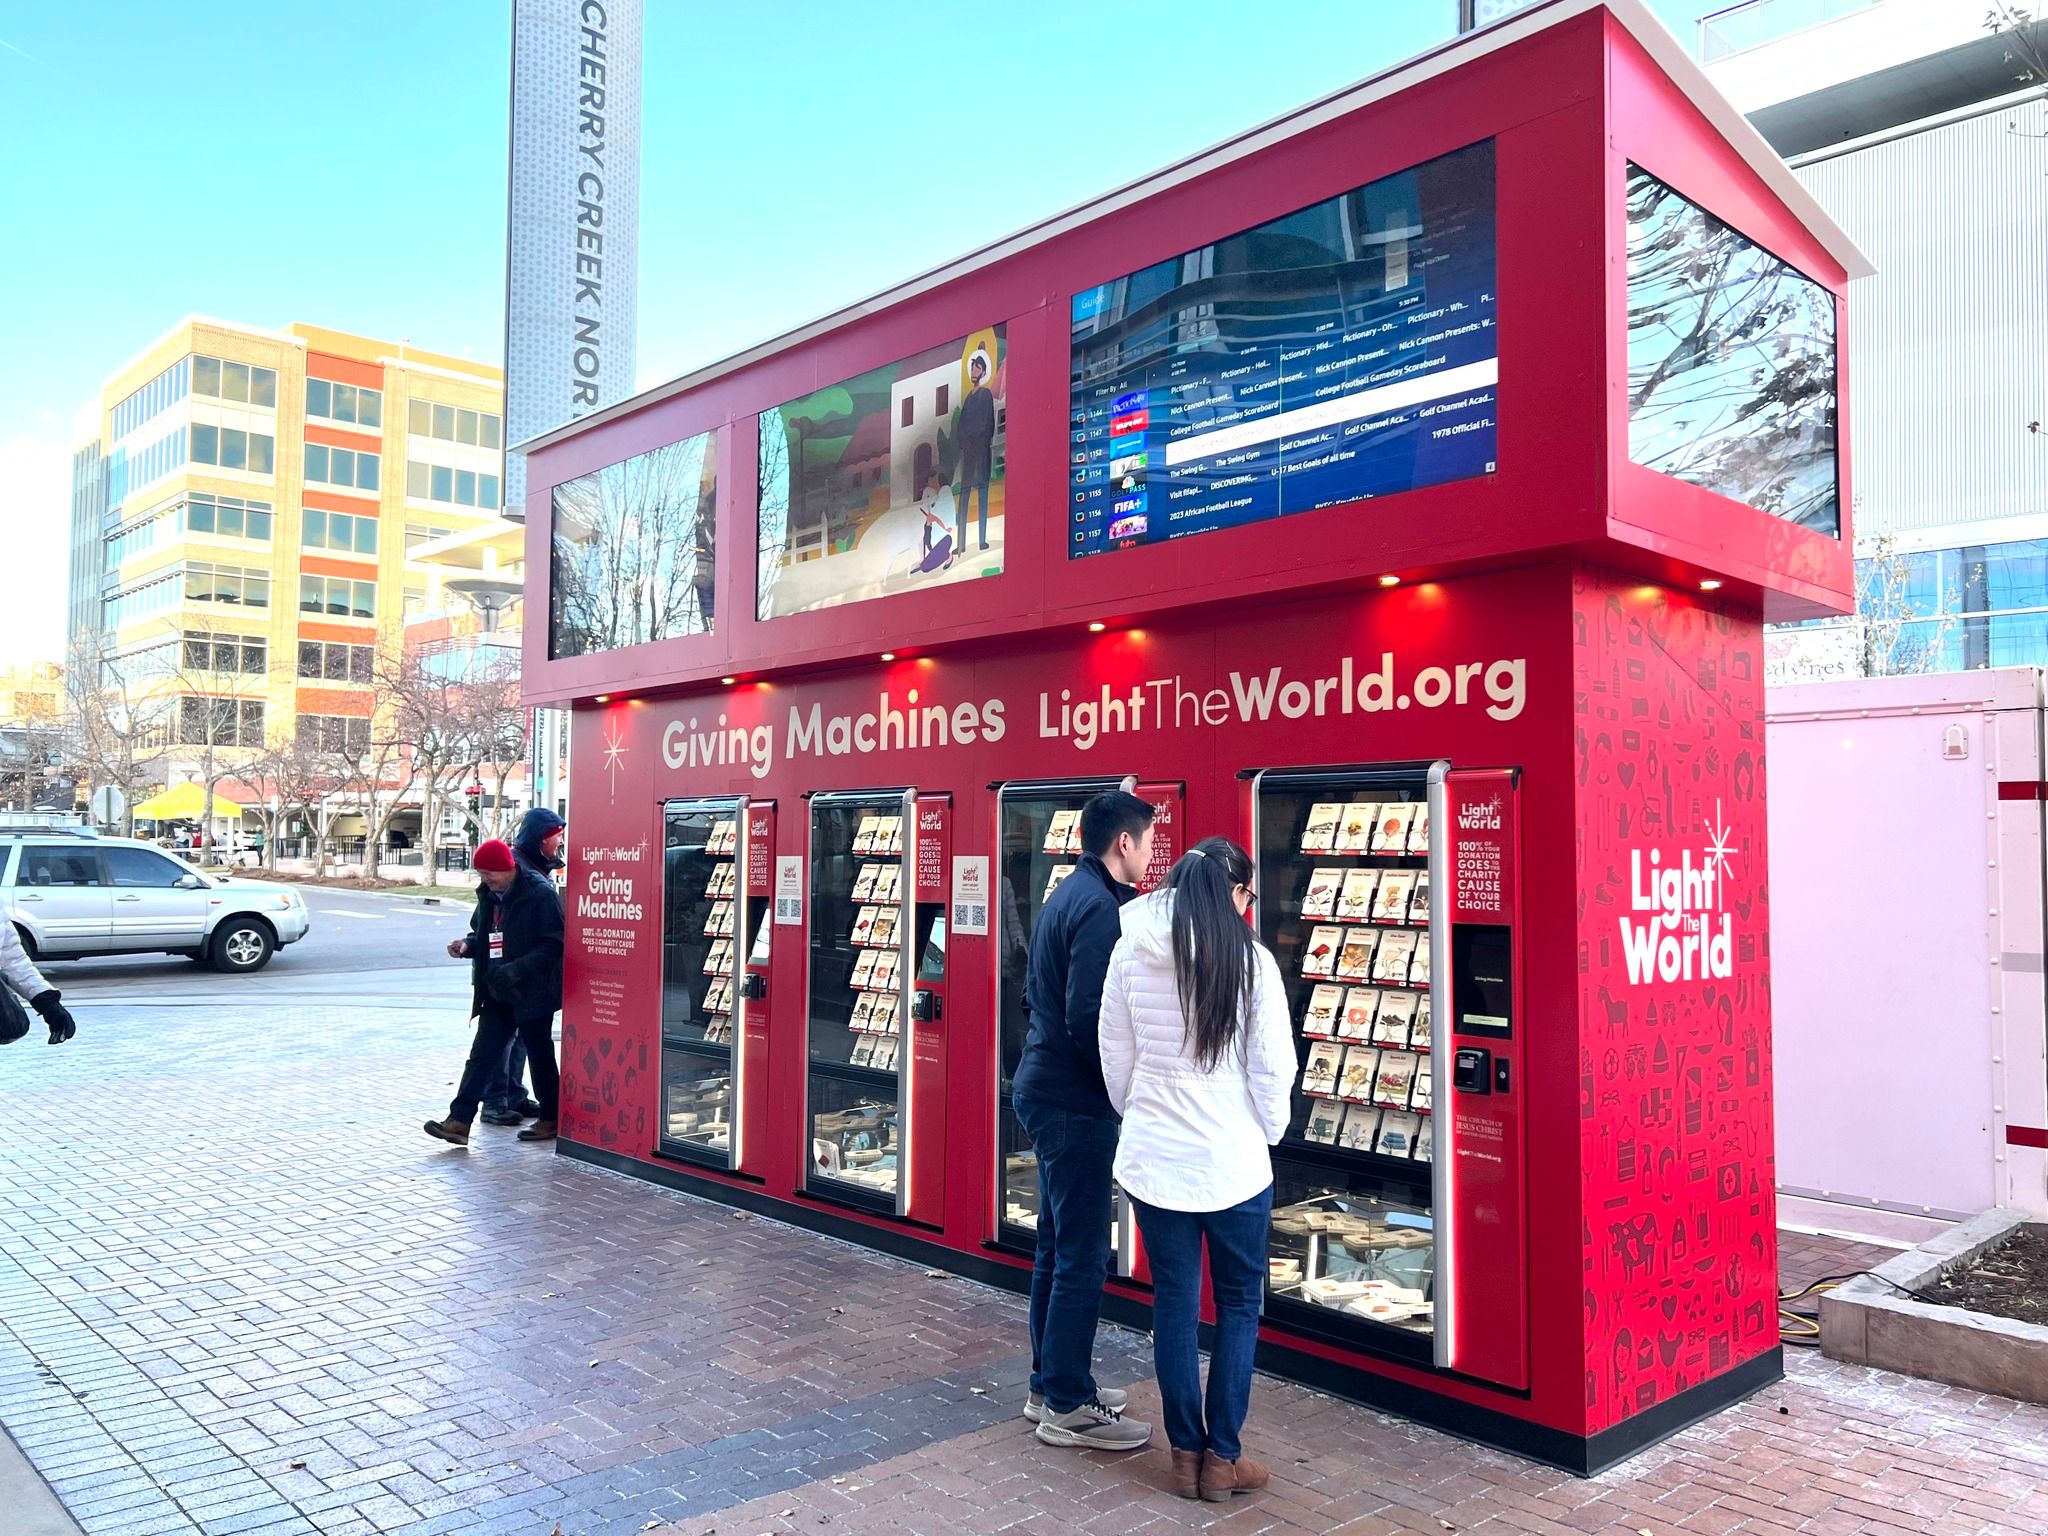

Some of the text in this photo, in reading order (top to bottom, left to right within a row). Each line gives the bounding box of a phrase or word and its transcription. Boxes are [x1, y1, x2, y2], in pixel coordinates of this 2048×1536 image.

[573, 0, 607, 418] CHERRY CREEK NOR
[1081, 294, 1104, 309] Guide
[1408, 308, 1444, 324] Pictionary
[1343, 327, 1376, 344] Pictionary
[1399, 340, 1415, 351] Nick
[1416, 332, 1444, 346] Cannon
[1445, 323, 1481, 338] Presents:
[1280, 347, 1311, 361] Pictionary
[1221, 365, 1251, 379] Pictionary
[1315, 363, 1330, 374] Nick
[1331, 358, 1356, 370] Cannon
[1315, 355, 1446, 397] College Football Gameday Scoreboard
[1171, 382, 1198, 395] Pictionary
[1240, 386, 1253, 396] Nick
[1254, 379, 1277, 391] Cannon
[1170, 407, 1182, 415] Nick
[1183, 401, 1205, 412] Cannon
[1419, 406, 1436, 418] Golf
[1436, 399, 1468, 414] Channel
[1170, 423, 1191, 436] College
[1192, 417, 1215, 430] Football
[1216, 411, 1243, 424] Gameday
[1244, 400, 1279, 416] Scoreboard
[1090, 429, 1102, 438] 1147
[1345, 425, 1359, 436] Golf
[1360, 418, 1389, 432] Channel
[1432, 428, 1451, 439] 1978
[1452, 421, 1480, 435] Official
[1279, 442, 1293, 452] Golf
[1293, 436, 1320, 449] Channel
[1090, 449, 1102, 458] 1152
[1216, 450, 1260, 467] The Swing Gym
[1271, 450, 1356, 476] U-17 Best Goals of all time
[1170, 469, 1180, 478] The
[1180, 466, 1197, 477] Swing
[1089, 489, 1101, 498] 1155
[1129, 484, 1146, 494] PASS
[1170, 490, 1182, 500] Visit
[1114, 499, 1142, 514] FIFA+
[1170, 497, 1253, 521] 2023 African Football League
[1089, 510, 1101, 519] 1156
[1088, 529, 1101, 538] 1157
[1039, 652, 1526, 751] LightTheWorld.org
[662, 688, 1006, 779] Giving Machines
[922, 812, 938, 822] Light
[1462, 803, 1494, 818] Light
[752, 820, 766, 830] Light
[920, 821, 942, 830] World
[1152, 813, 1171, 824] orld
[1458, 816, 1501, 829] World
[751, 827, 768, 836] World
[1458, 842, 1483, 851] 100%
[582, 847, 640, 865] LightTheWorld
[919, 851, 936, 859] GOES
[1458, 852, 1500, 860] DONATION
[1145, 866, 1171, 874] AUSE
[1458, 860, 1490, 870] GOES
[1458, 870, 1500, 879] CHARITY
[588, 871, 633, 902] Giving
[1458, 880, 1500, 891] CAUSE
[1631, 848, 1715, 930] Light
[1458, 891, 1500, 900] OF YOUR
[577, 895, 643, 920] Machines
[1458, 900, 1500, 911] CHOICE
[1682, 914, 1699, 932] The
[603, 928, 635, 940] DONATION
[582, 937, 635, 948] GOES CHARITY CAUSE
[1619, 913, 1732, 985] World
[595, 946, 608, 954] YOUR
[609, 947, 627, 956] CHOICE
